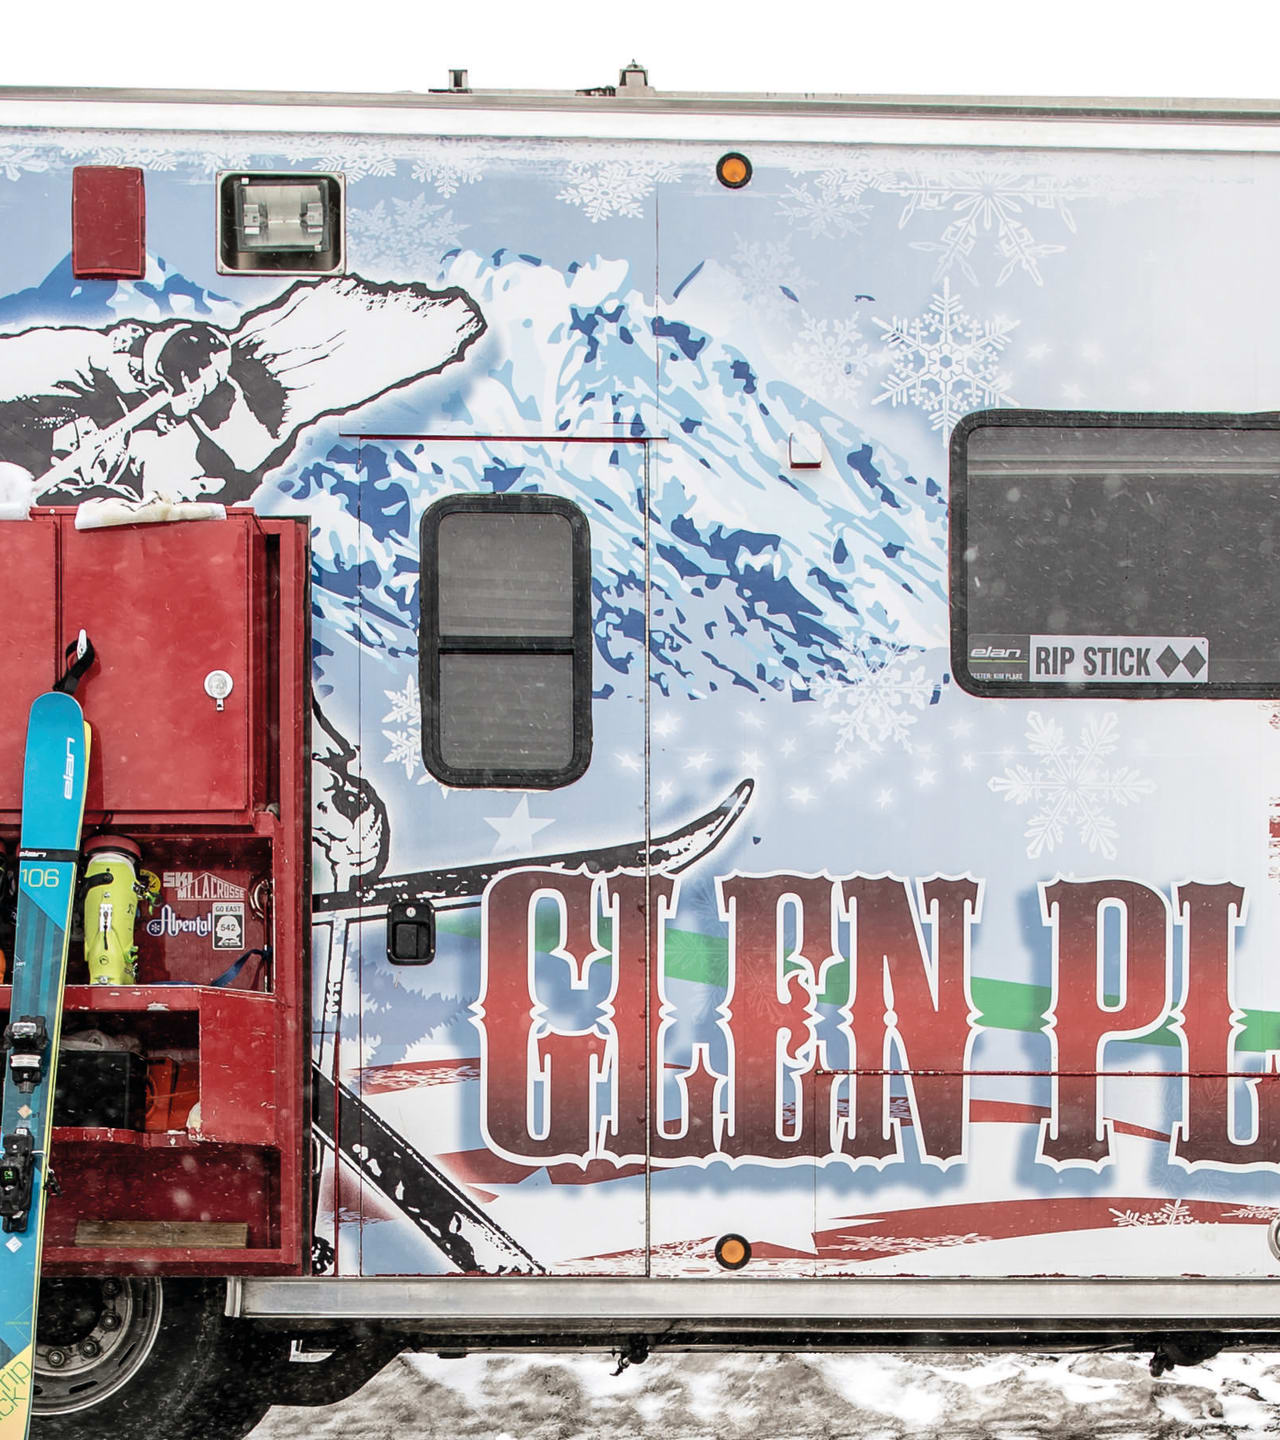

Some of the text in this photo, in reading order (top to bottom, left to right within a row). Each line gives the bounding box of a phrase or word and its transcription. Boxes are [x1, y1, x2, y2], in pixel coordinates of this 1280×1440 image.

[970, 646, 1021, 658] elan
[1035, 646, 1151, 676] RIP STICK
[63, 737, 76, 800] elan
[20, 868, 60, 888] 106
[163, 871, 193, 888] SKI
[195, 874, 245, 899] LACROSSE
[146, 904, 212, 937] Alpental
[225, 905, 241, 913] EAST
[220, 923, 236, 931] 542
[472, 867, 986, 1172] GLEN
[0, 1361, 31, 1392] rip
